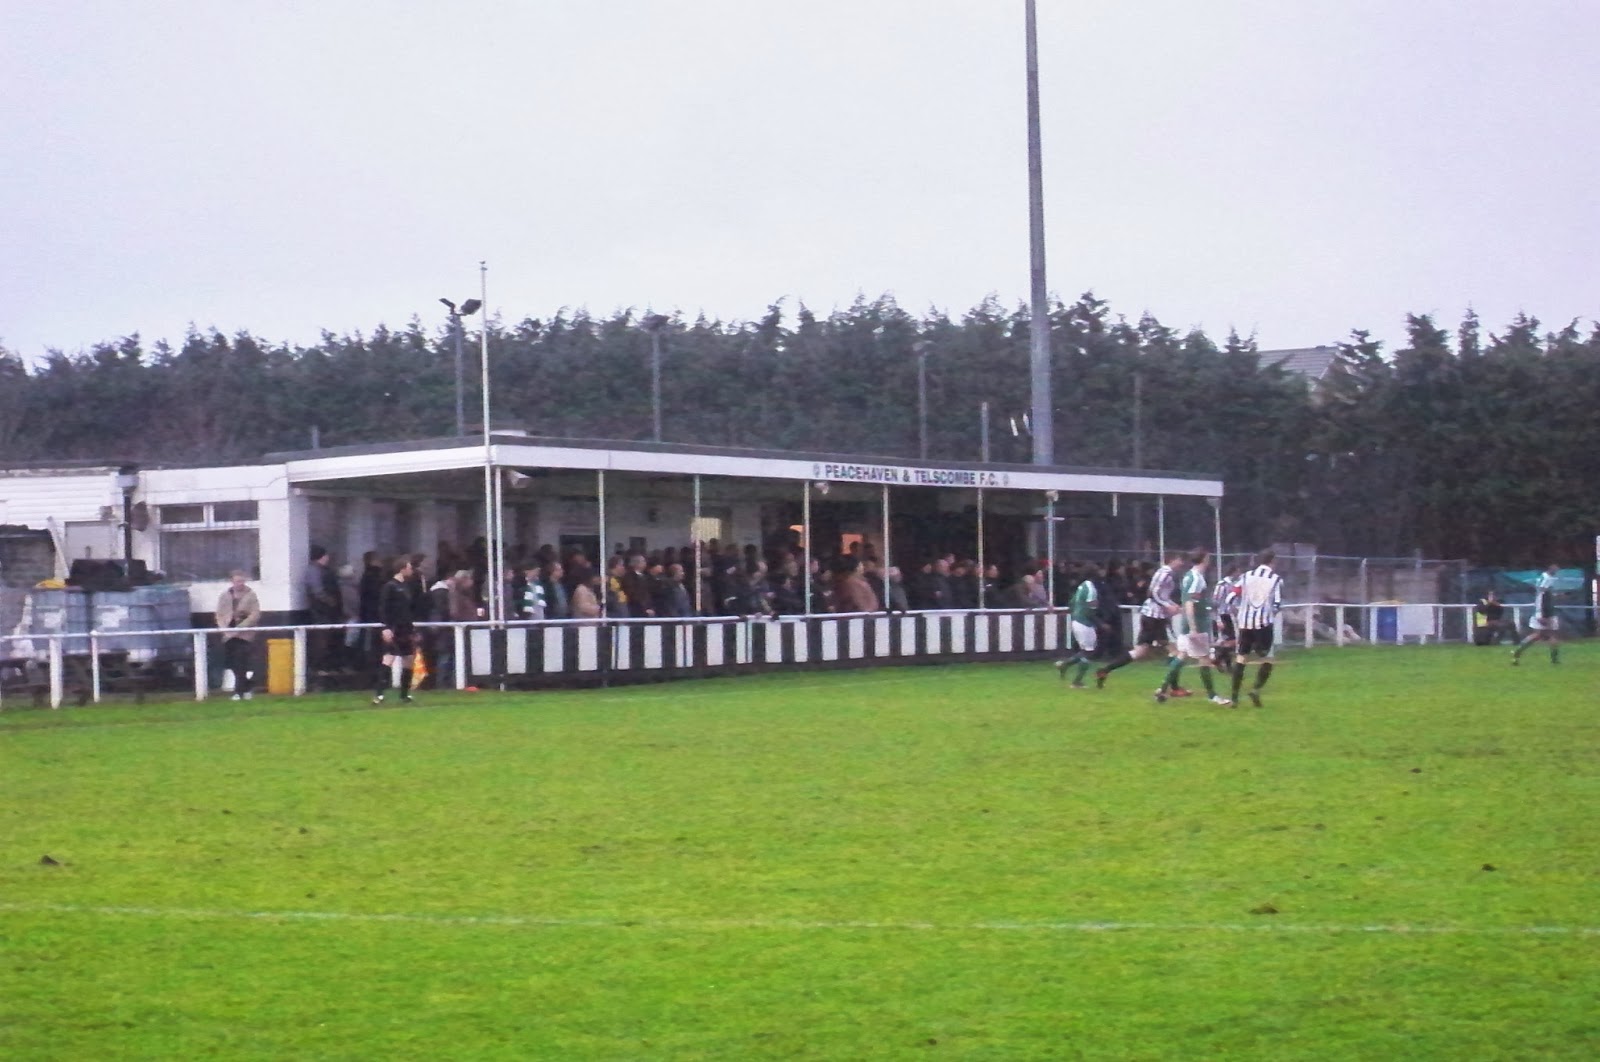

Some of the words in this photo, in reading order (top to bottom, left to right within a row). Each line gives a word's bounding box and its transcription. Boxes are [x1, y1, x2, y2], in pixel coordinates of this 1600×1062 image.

[825, 464, 898, 482] PEACEHAVEN
[902, 469, 911, 483] &
[914, 469, 976, 485] TELSCOMBE
[979, 472, 999, 486] F.C.
